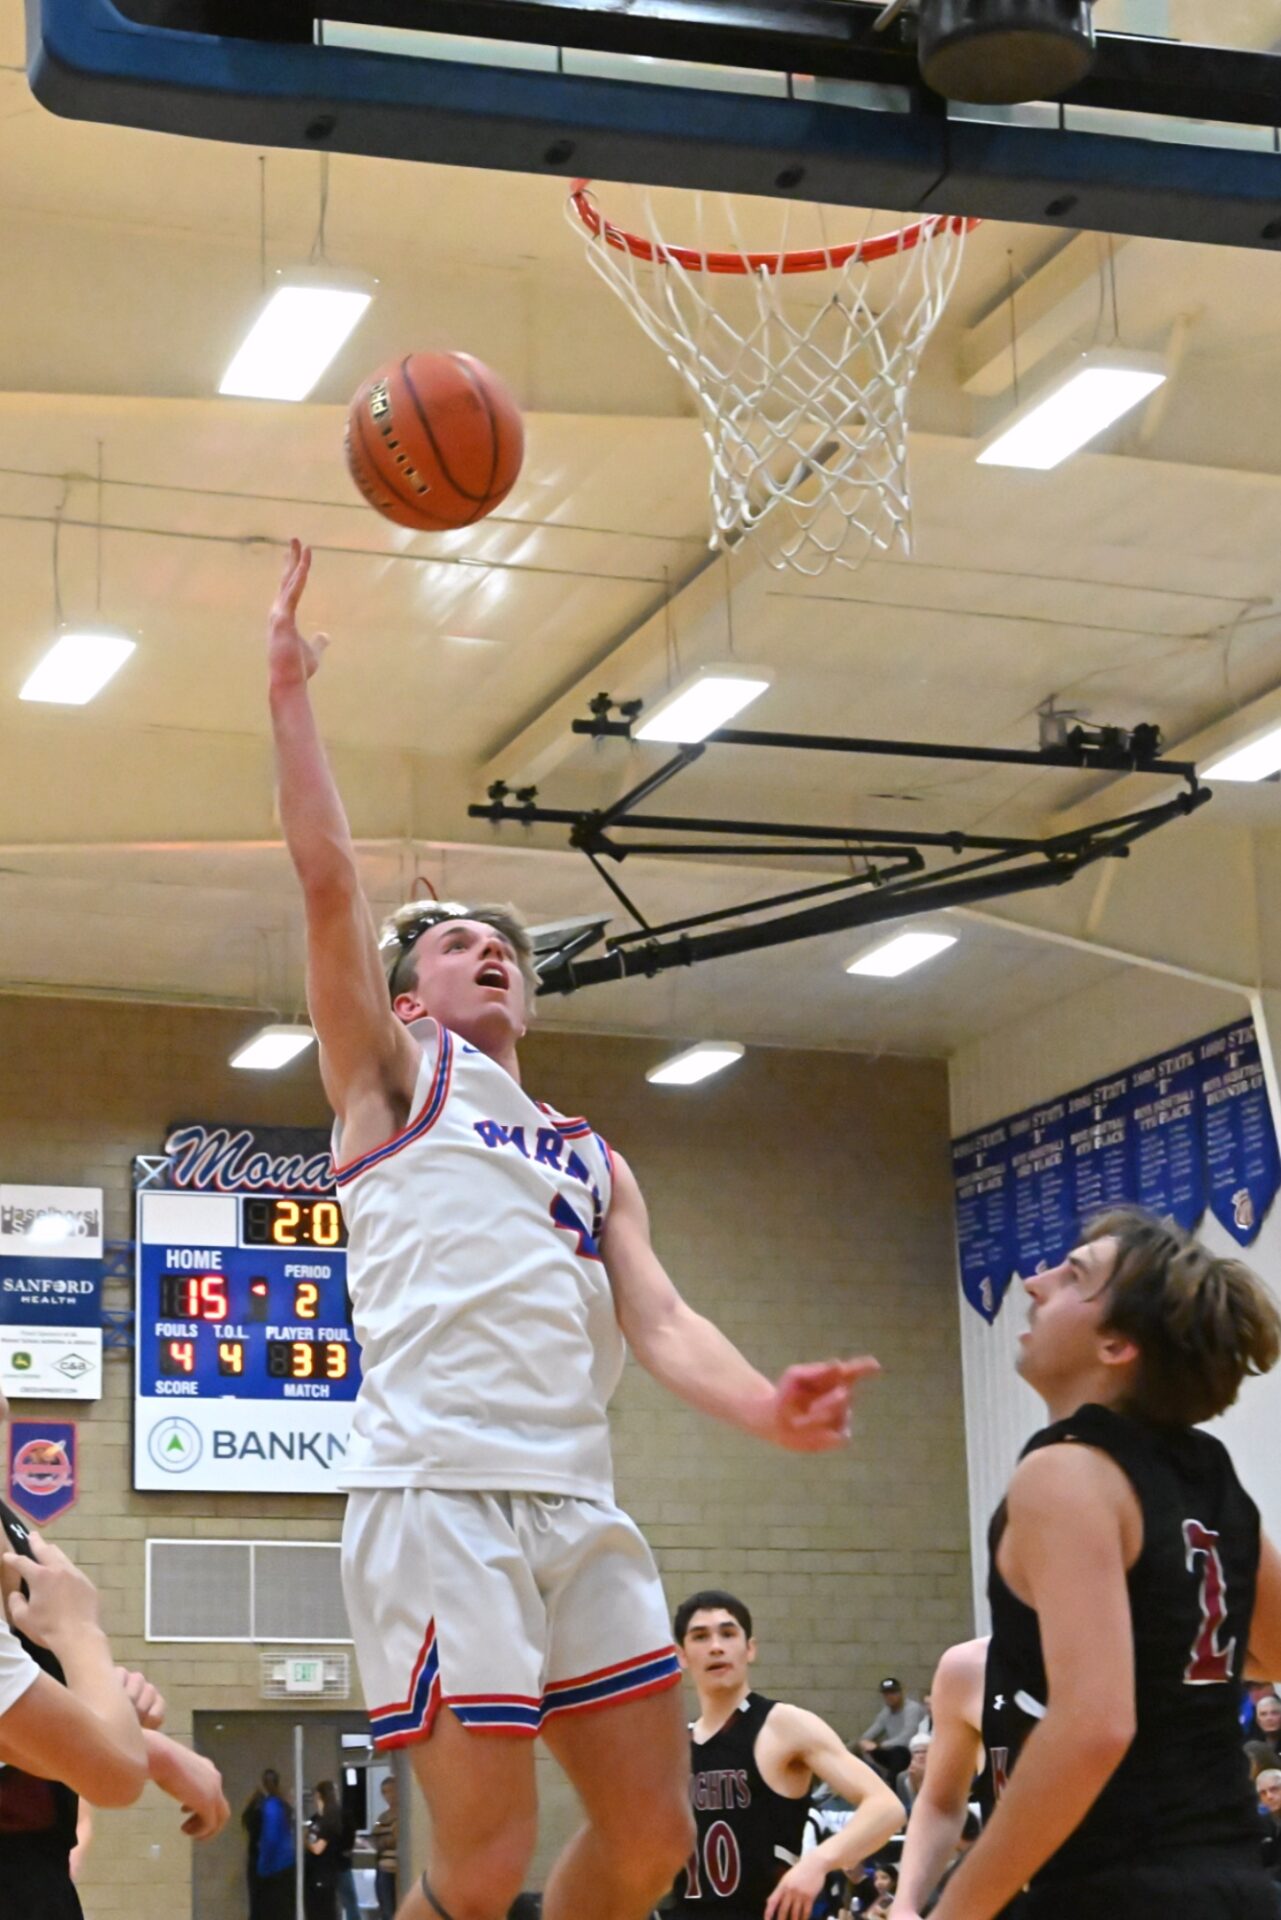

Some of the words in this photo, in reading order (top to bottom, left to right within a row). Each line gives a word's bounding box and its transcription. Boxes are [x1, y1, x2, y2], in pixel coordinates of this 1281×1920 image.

[166, 1249, 223, 1270] HOME
[284, 1264, 332, 1279] PERIOD
[3, 1278, 95, 1294] SANFORD
[20, 1296, 77, 1304] HEALTH
[189, 1277, 227, 1319] 15
[295, 1283, 318, 1318] 2
[155, 1323, 198, 1338] FOULS
[265, 1326, 314, 1340] PLAYER
[318, 1328, 351, 1342] FOUL
[169, 1342, 194, 1372] 4
[219, 1343, 243, 1373] 4
[155, 1380, 198, 1395] SCORE
[283, 1384, 330, 1398] MATCH
